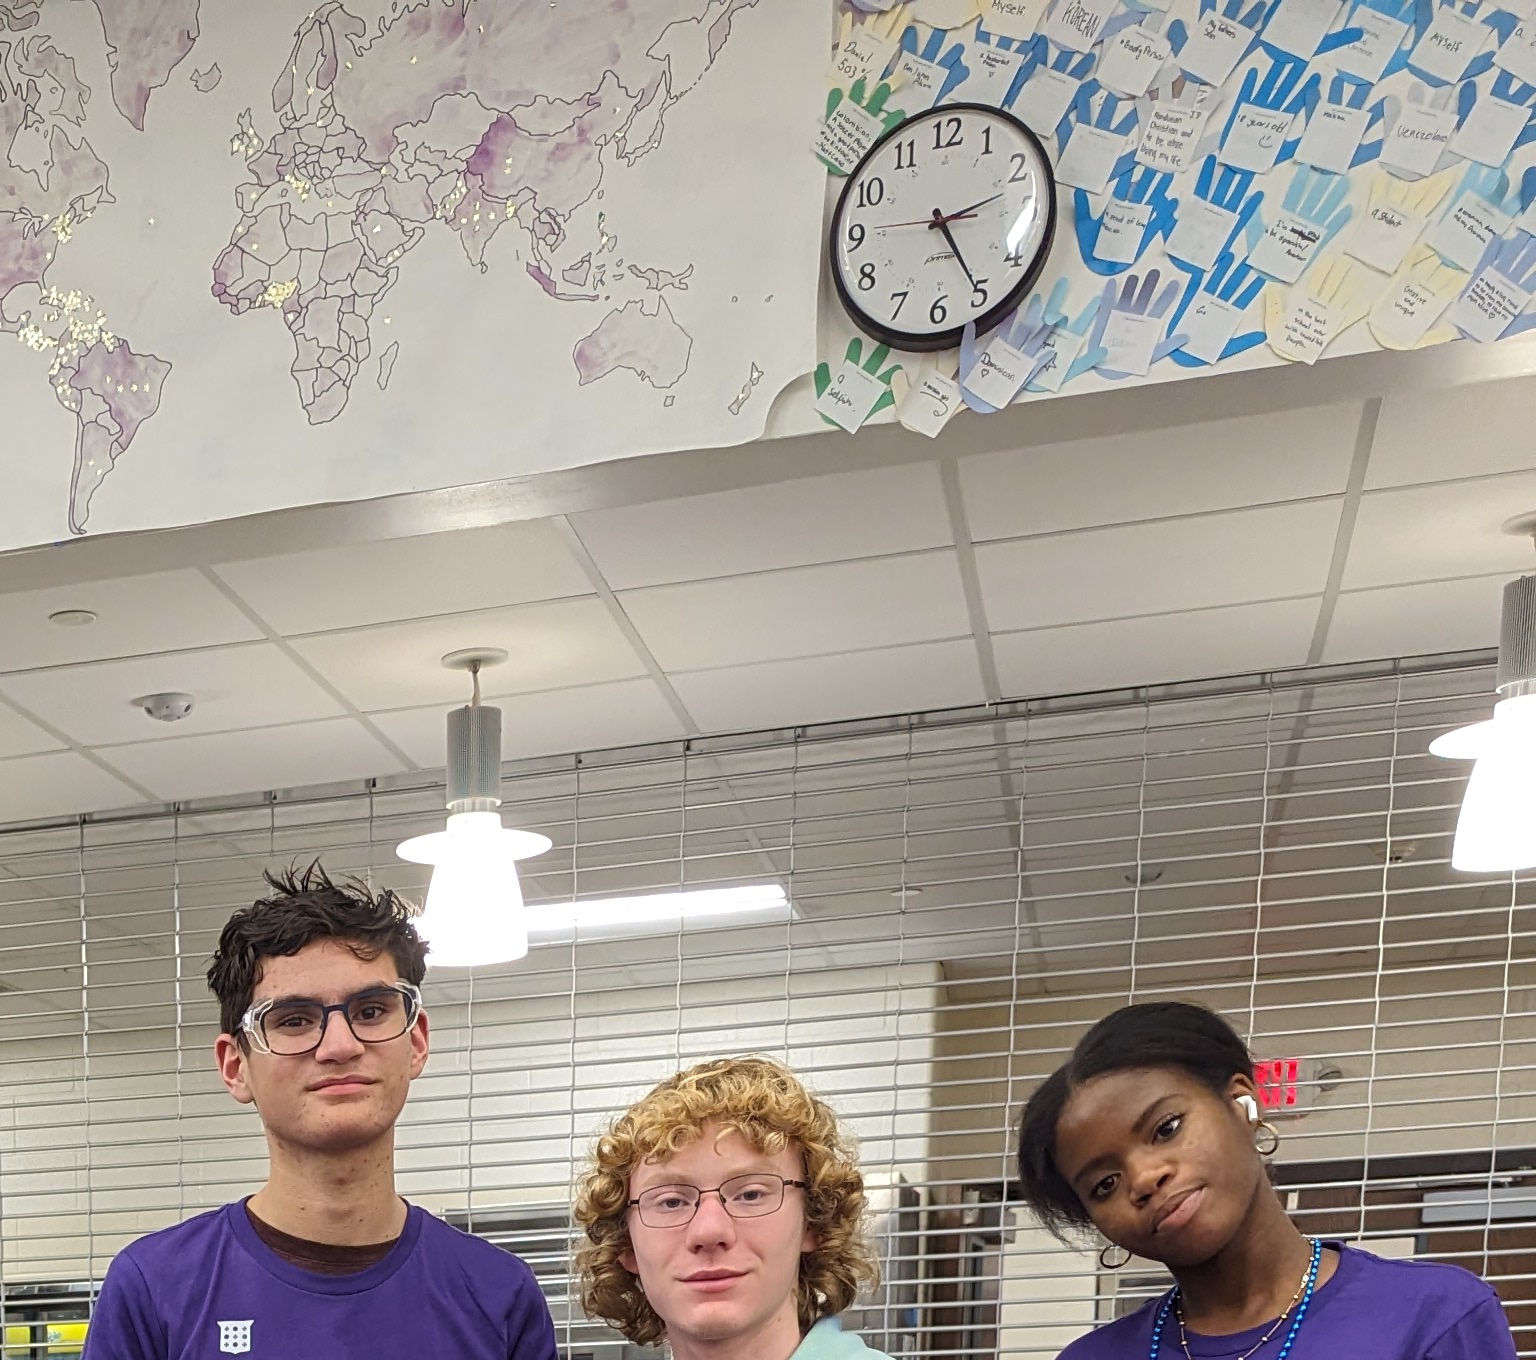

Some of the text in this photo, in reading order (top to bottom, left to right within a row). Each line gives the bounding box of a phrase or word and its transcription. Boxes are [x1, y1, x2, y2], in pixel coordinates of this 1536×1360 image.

[1062, 3, 1098, 37] KOREAN
[843, 41, 873, 62] Daniel
[837, 57, 857, 78] 503
[932, 117, 964, 150] 12
[981, 126, 992, 155] 1
[894, 139, 917, 170] 11
[1007, 153, 1027, 183] 2
[856, 177, 884, 208] 10
[848, 224, 865, 254] 9
[858, 263, 876, 291] 8
[890, 291, 908, 322] 7
[970, 278, 989, 308] 5
[1403, 285, 1426, 304] Creative
[929, 294, 949, 325] 6
